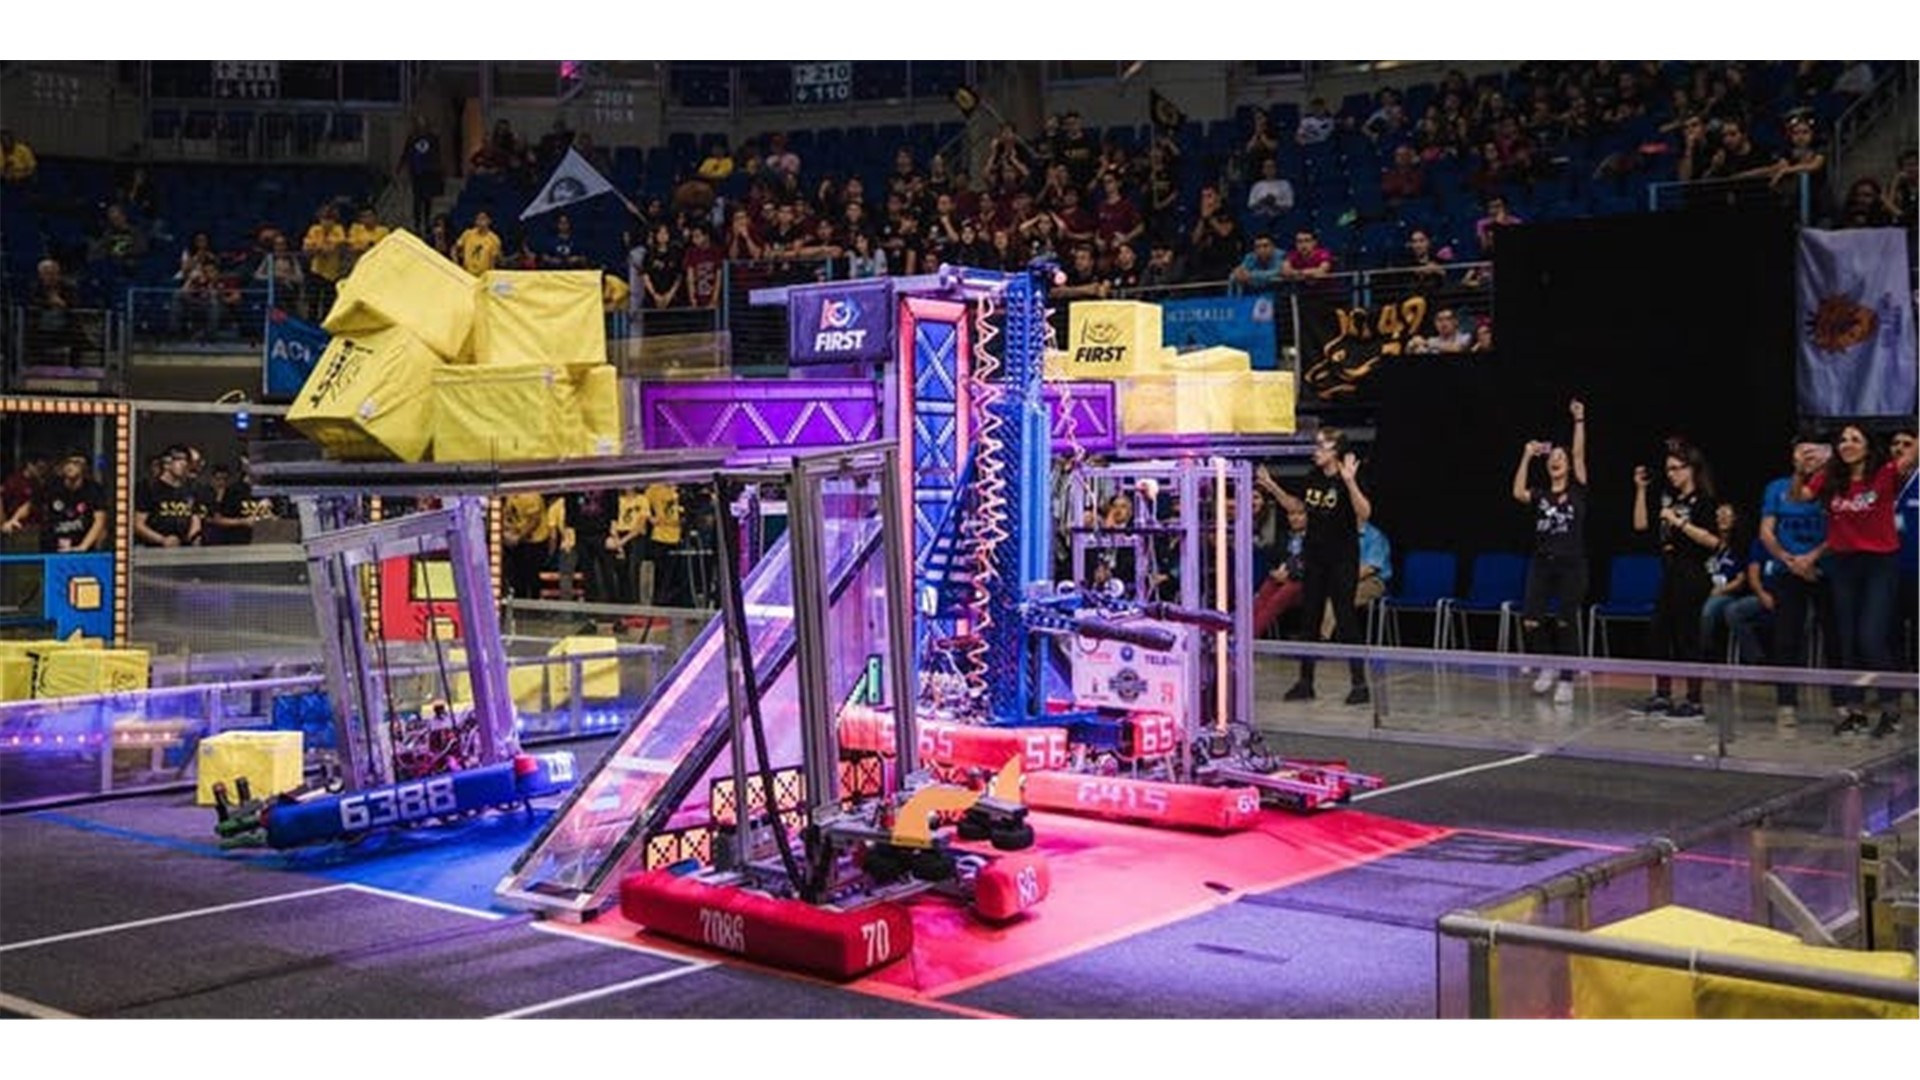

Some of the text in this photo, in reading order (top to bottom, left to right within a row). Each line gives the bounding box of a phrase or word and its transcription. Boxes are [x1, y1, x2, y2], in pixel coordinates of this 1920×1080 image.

[815, 84, 849, 99] 110
[814, 329, 867, 352] FIRST
[1074, 346, 1126, 363] FIRST
[1142, 718, 1175, 752] 65
[1025, 734, 1067, 773] 56
[340, 776, 458, 831] 6388
[1077, 781, 1168, 815] 6415
[700, 906, 746, 954] 7086
[860, 918, 890, 967] 70
